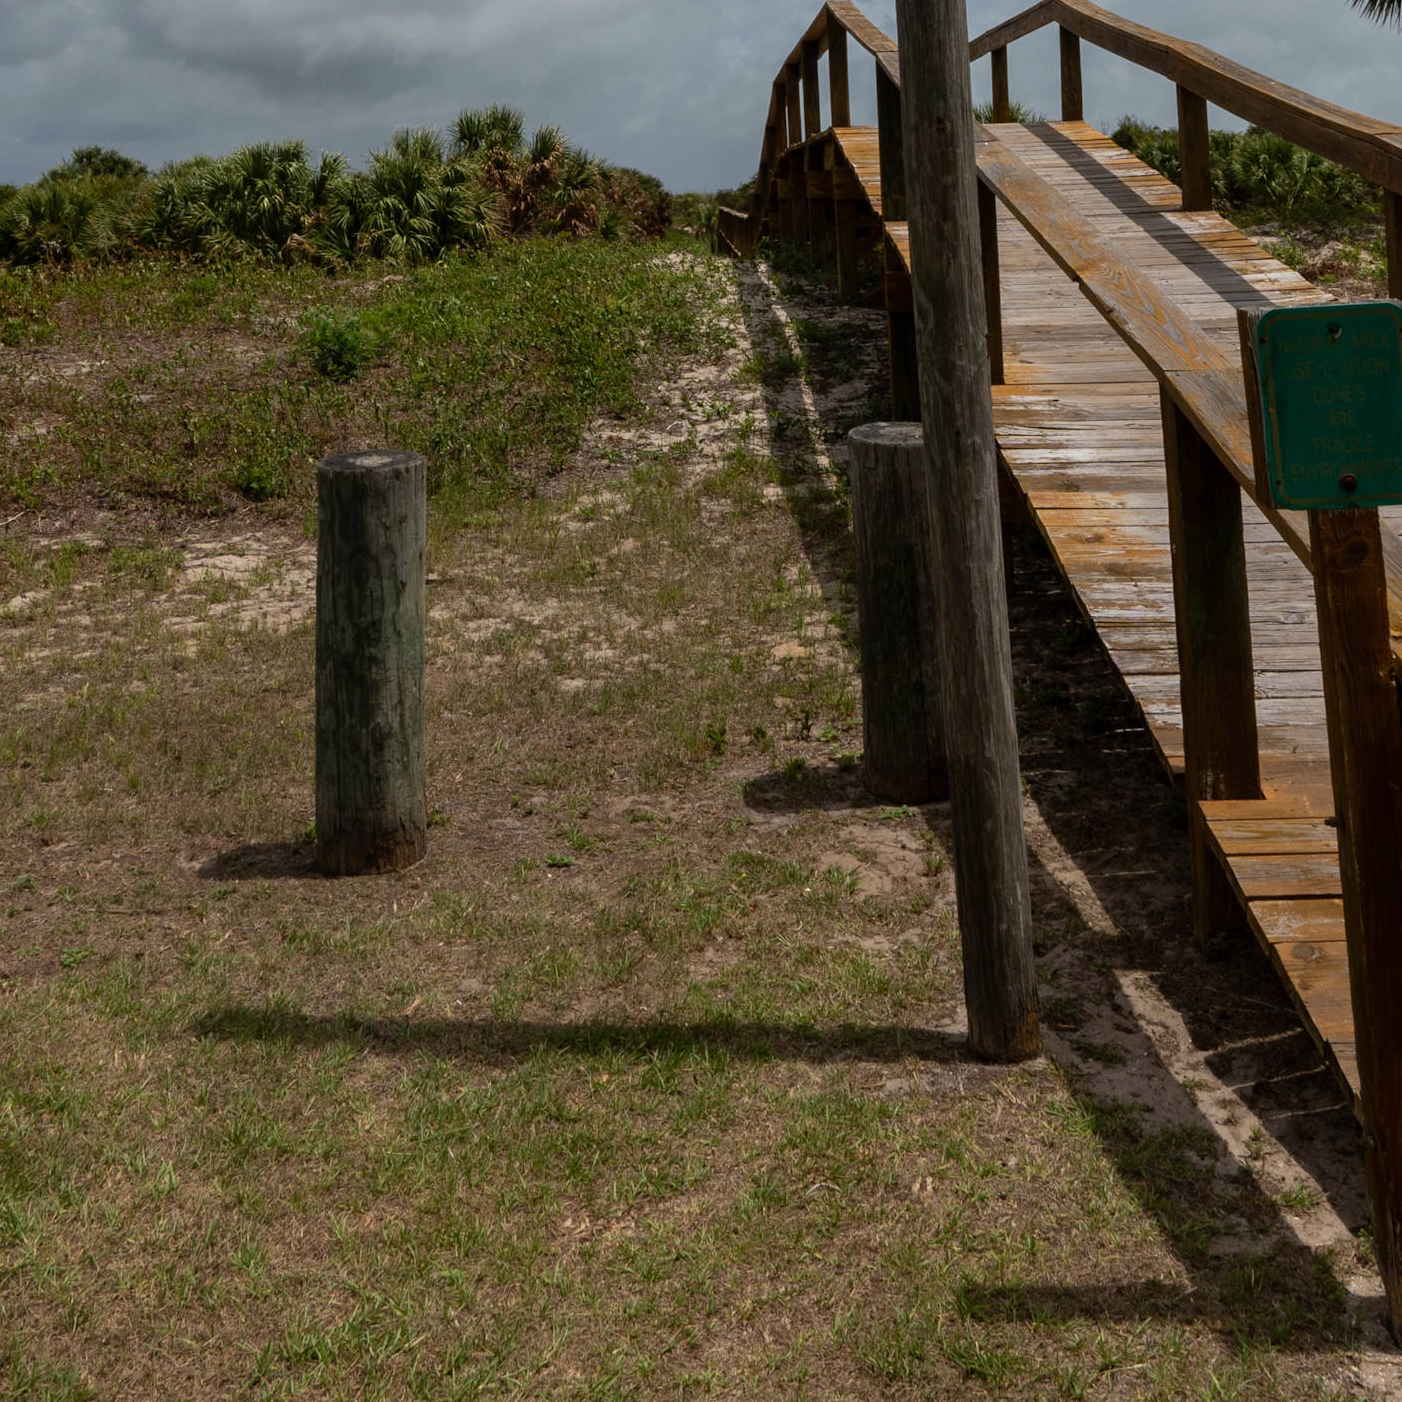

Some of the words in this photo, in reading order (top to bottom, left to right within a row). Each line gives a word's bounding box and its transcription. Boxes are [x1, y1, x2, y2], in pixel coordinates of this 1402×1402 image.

[1313, 383, 1365, 404] DUNES
[1327, 409, 1357, 428] ARE
[1312, 434, 1374, 454] FRAGILE
